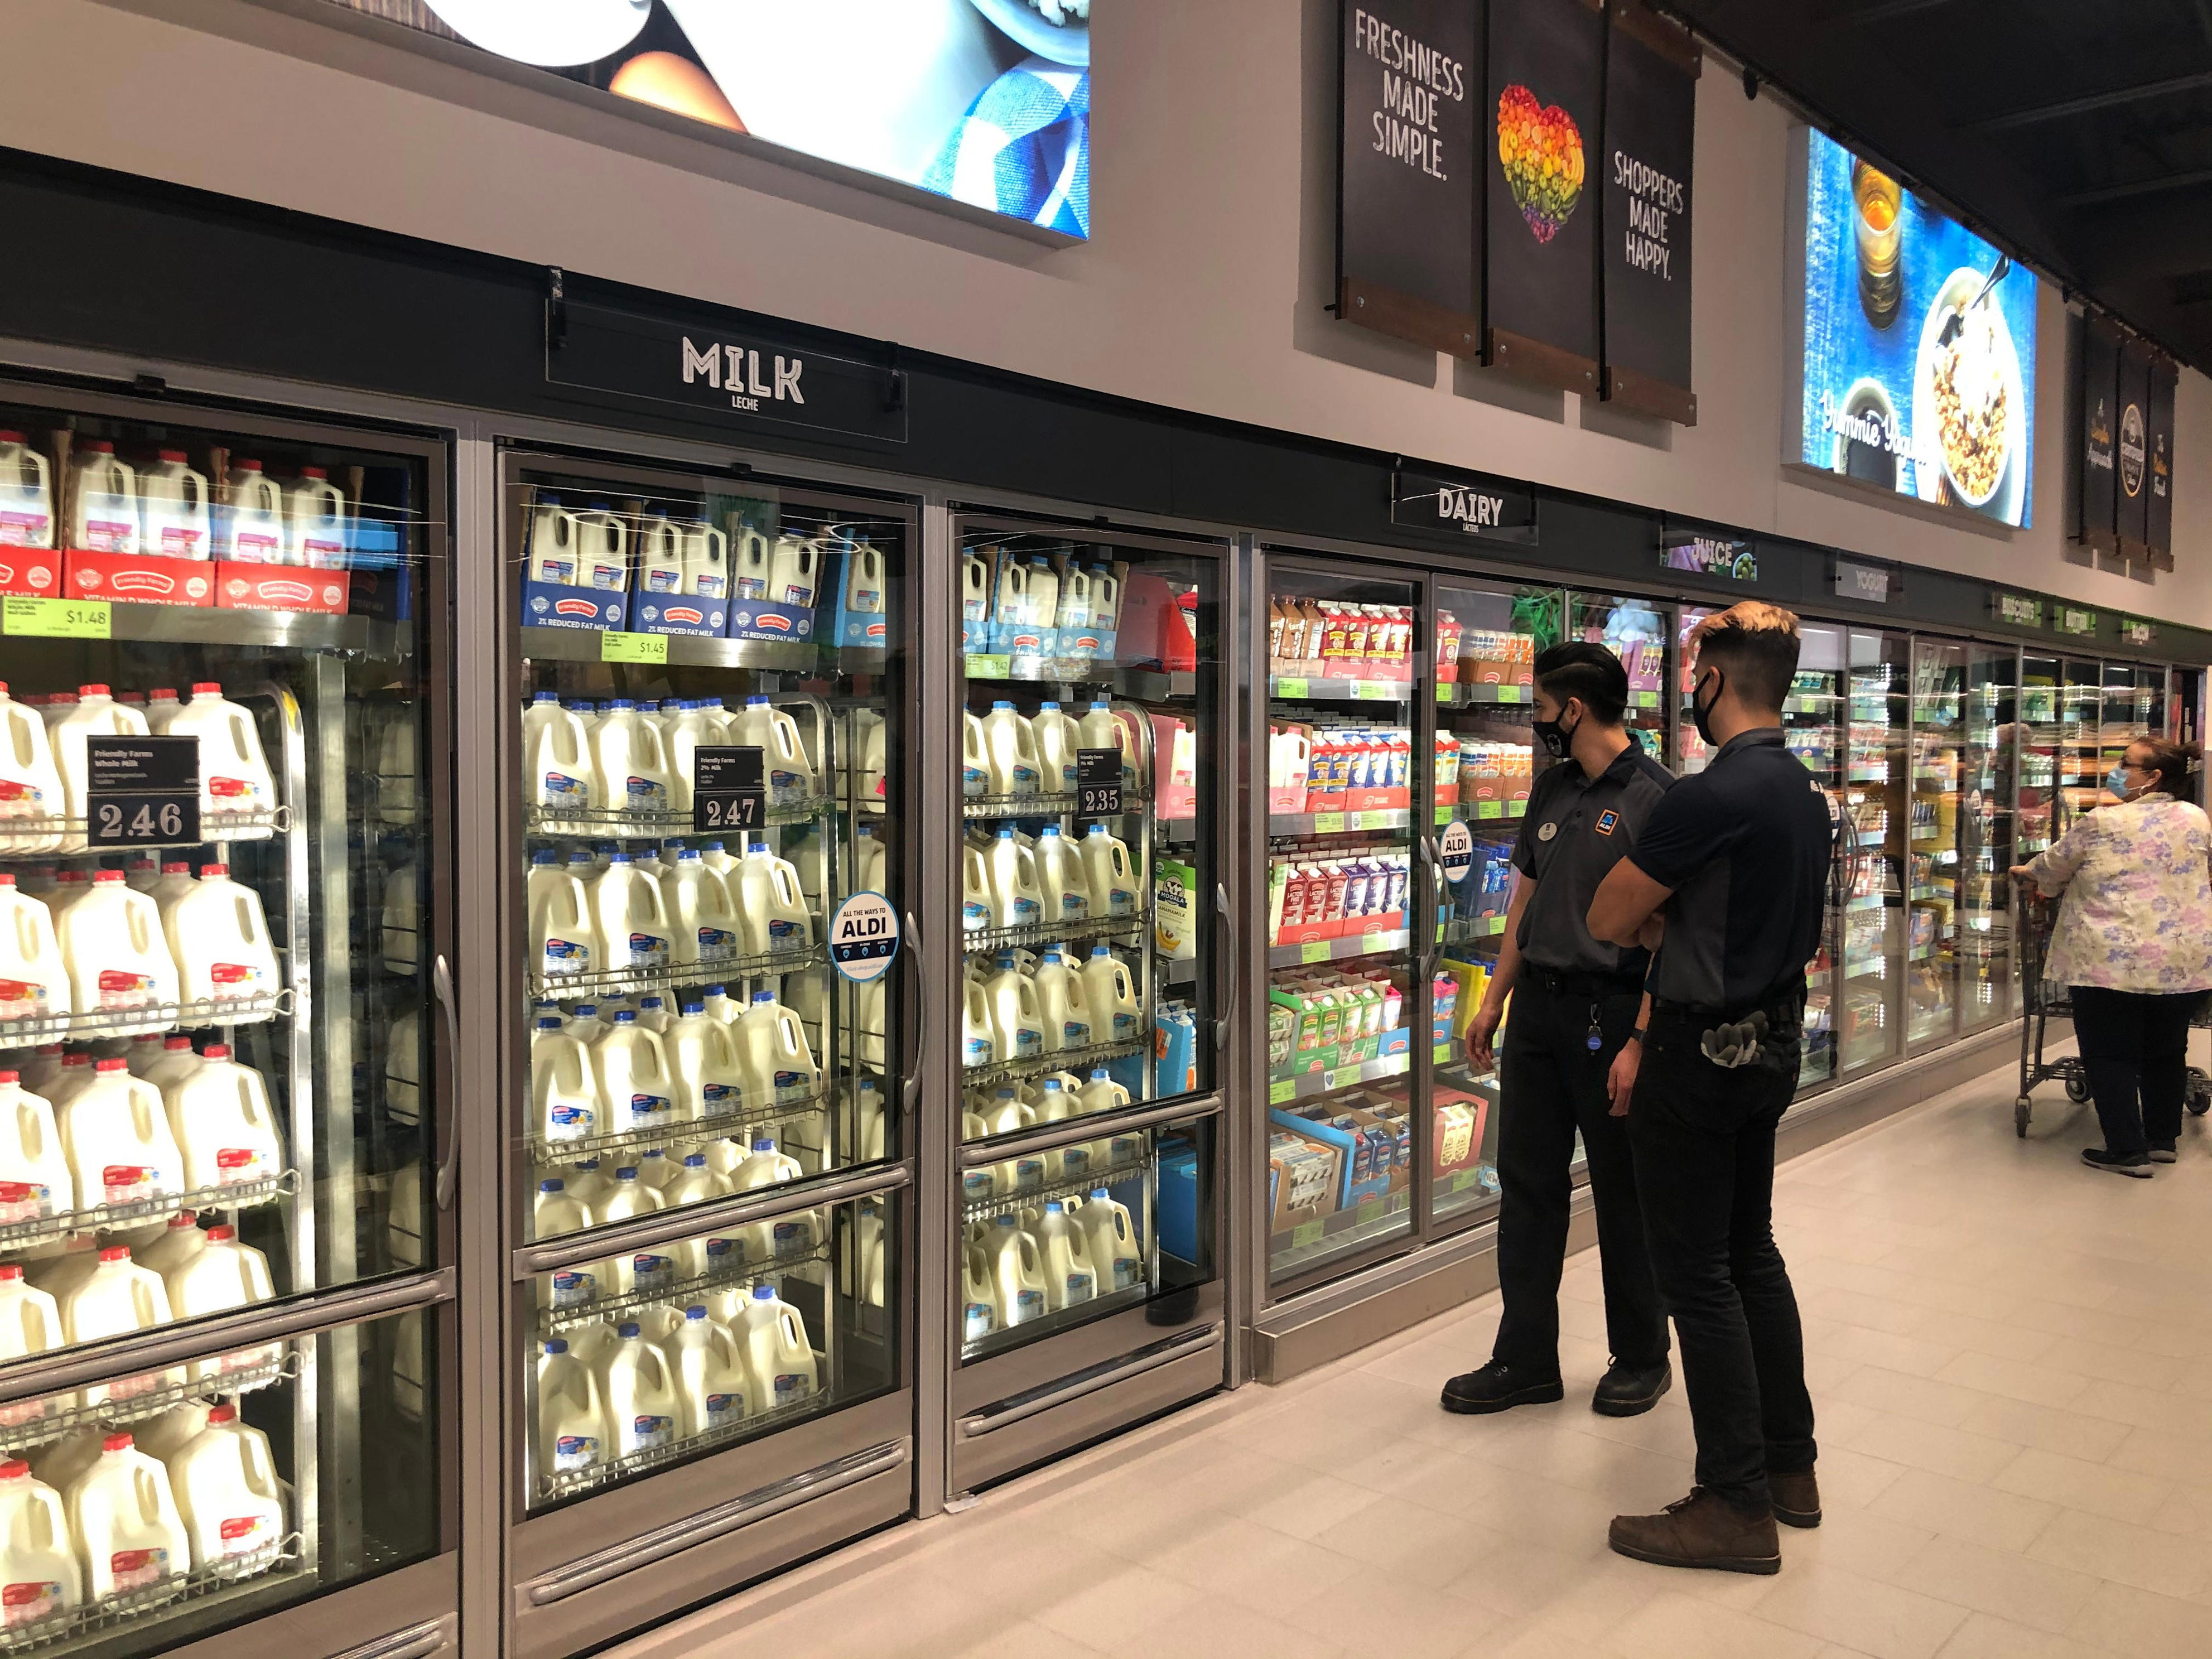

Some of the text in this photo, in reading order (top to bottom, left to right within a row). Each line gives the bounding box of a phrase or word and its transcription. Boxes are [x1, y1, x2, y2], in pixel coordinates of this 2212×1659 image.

[1355, 8, 1464, 101] FRESHNESS
[1384, 70, 1438, 133] MADE
[1372, 111, 1447, 181] SIMPLE.
[1614, 150, 1683, 214] SHOPPERS
[1630, 195, 1668, 243] MADE
[1626, 231, 1671, 281] HAPPY.
[682, 336, 804, 404] MILK
[732, 395, 759, 411] LECHE
[1819, 389, 1881, 447] Yummie
[1439, 488, 1503, 526] DAIRY
[1691, 537, 1732, 567] JUICE
[1856, 570, 1888, 592] YOGURT
[66, 610, 107, 624] $1.48
[548, 618, 580, 628] REDUCED
[657, 626, 686, 635] REDUCED
[749, 631, 776, 640] REDUCED
[640, 642, 664, 653] $1.45
[1086, 789, 1118, 811] 2.35
[99, 803, 182, 837] 2.46
[707, 799, 755, 826] 2.47
[1445, 838, 1466, 852] ALDI
[1161, 891, 1184, 904] MOOALA
[842, 917, 886, 938] ALDI
[1486, 1173, 1498, 1184] NEW
